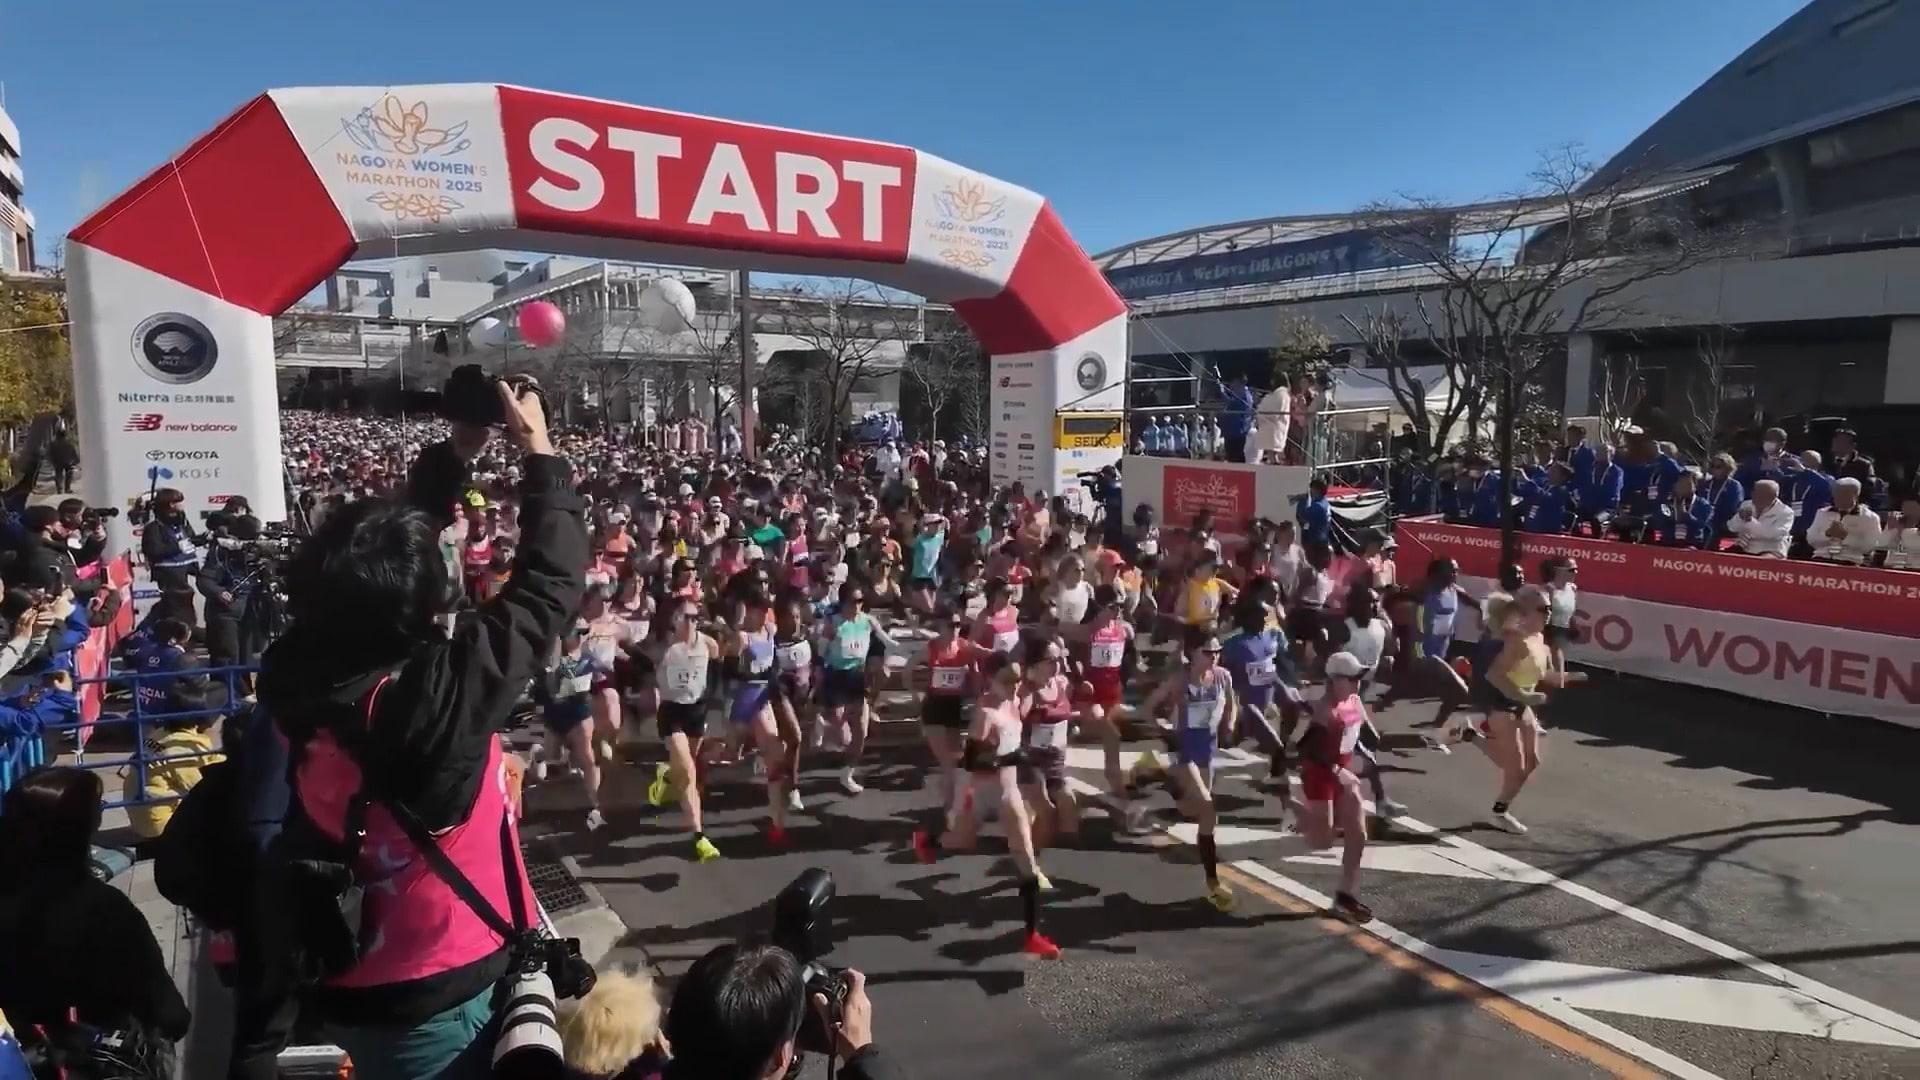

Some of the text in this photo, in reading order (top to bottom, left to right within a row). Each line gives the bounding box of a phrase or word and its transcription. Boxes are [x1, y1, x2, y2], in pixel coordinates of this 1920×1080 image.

[336, 152, 488, 176] NAGOYA WOMEN'S
[346, 171, 483, 193] MARATHON 2025
[527, 117, 901, 242] START
[1249, 249, 1331, 274] DRAGONS
[118, 393, 170, 403] Niterra
[165, 424, 188, 432] new
[191, 423, 238, 432] balance
[1074, 436, 1111, 447] SEIKO
[168, 451, 219, 460] TOYOTA
[1418, 532, 1462, 545] NAGOYA
[1521, 543, 1591, 560] MARATHON
[1593, 551, 1627, 564] 2025
[1653, 558, 1713, 575] NAGOYA
[1718, 565, 1794, 584] WOMEN'S
[1799, 575, 1901, 596] MARATHON
[1663, 623, 1920, 705] WOMEN
